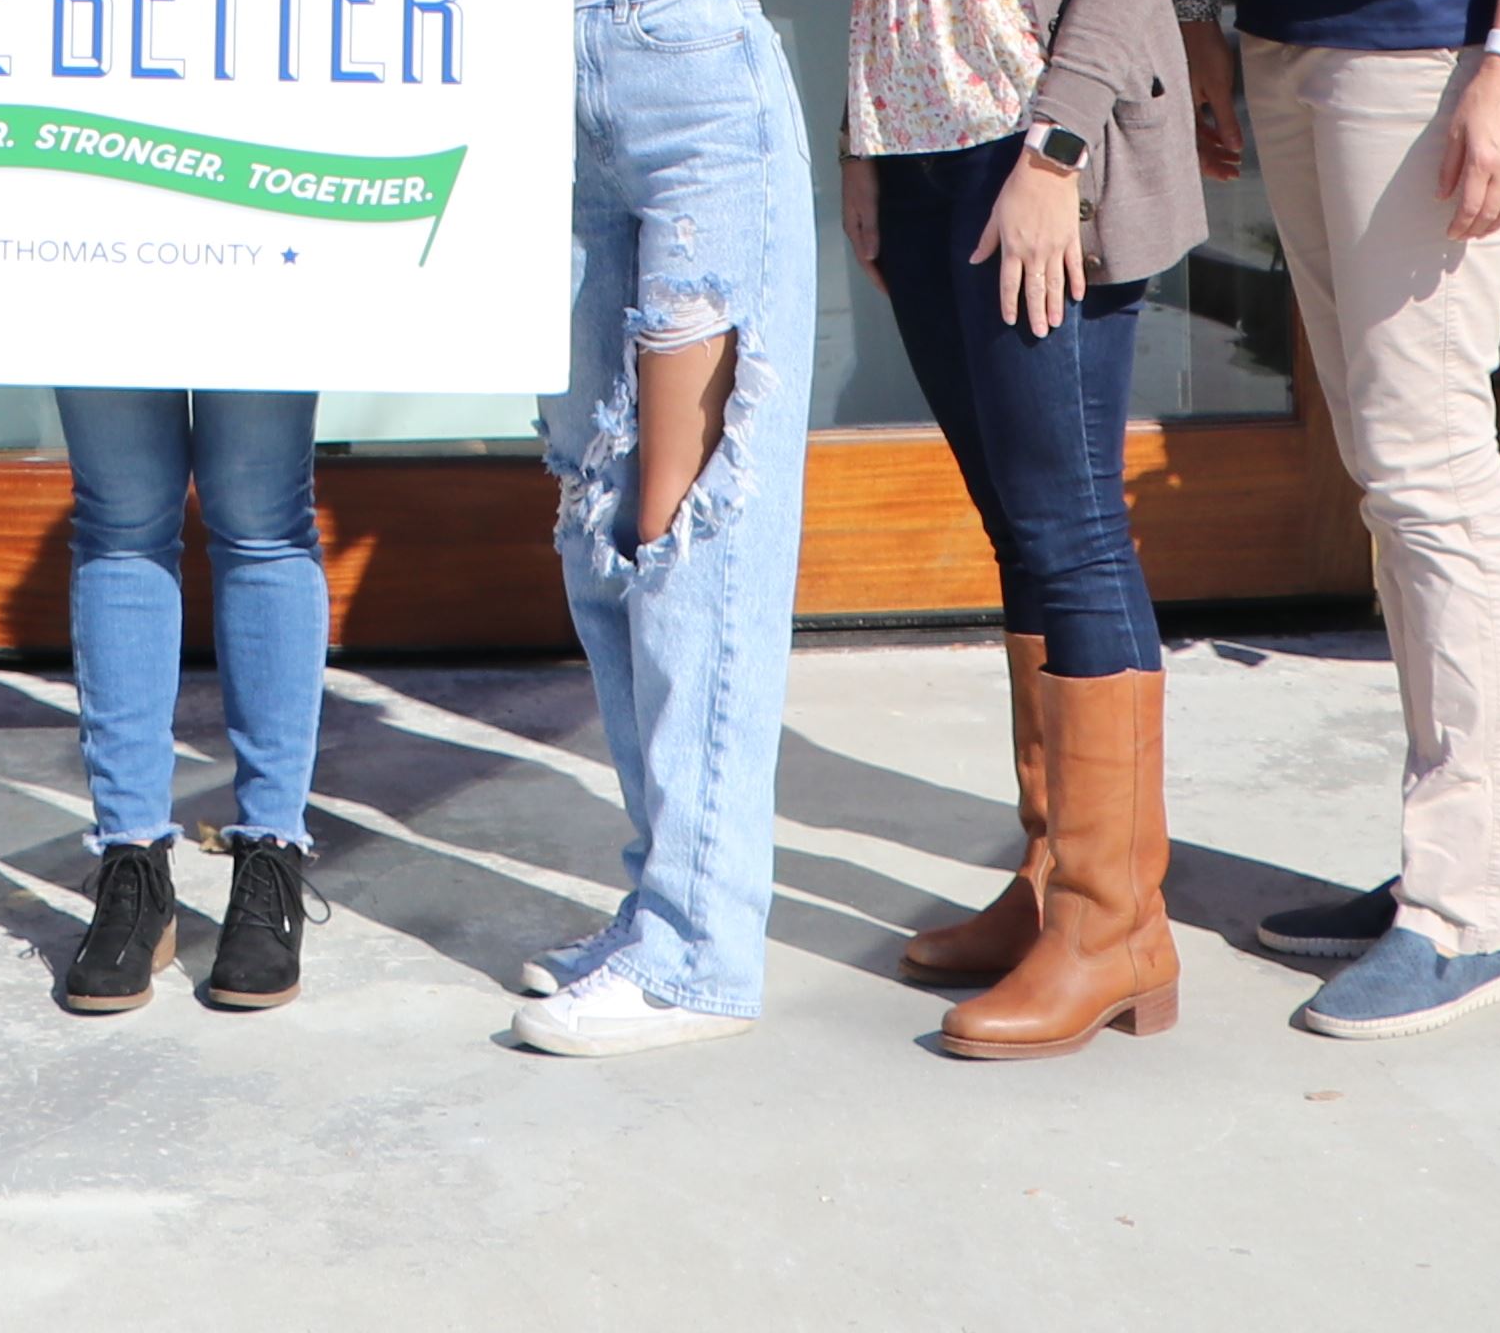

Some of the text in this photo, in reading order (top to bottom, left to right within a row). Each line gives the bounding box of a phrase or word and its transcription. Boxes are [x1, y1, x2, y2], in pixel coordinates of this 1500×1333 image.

[35, 123, 225, 182] STRONGER.
[248, 163, 434, 206] TOGETHER.
[137, 242, 263, 266] COUNTY
